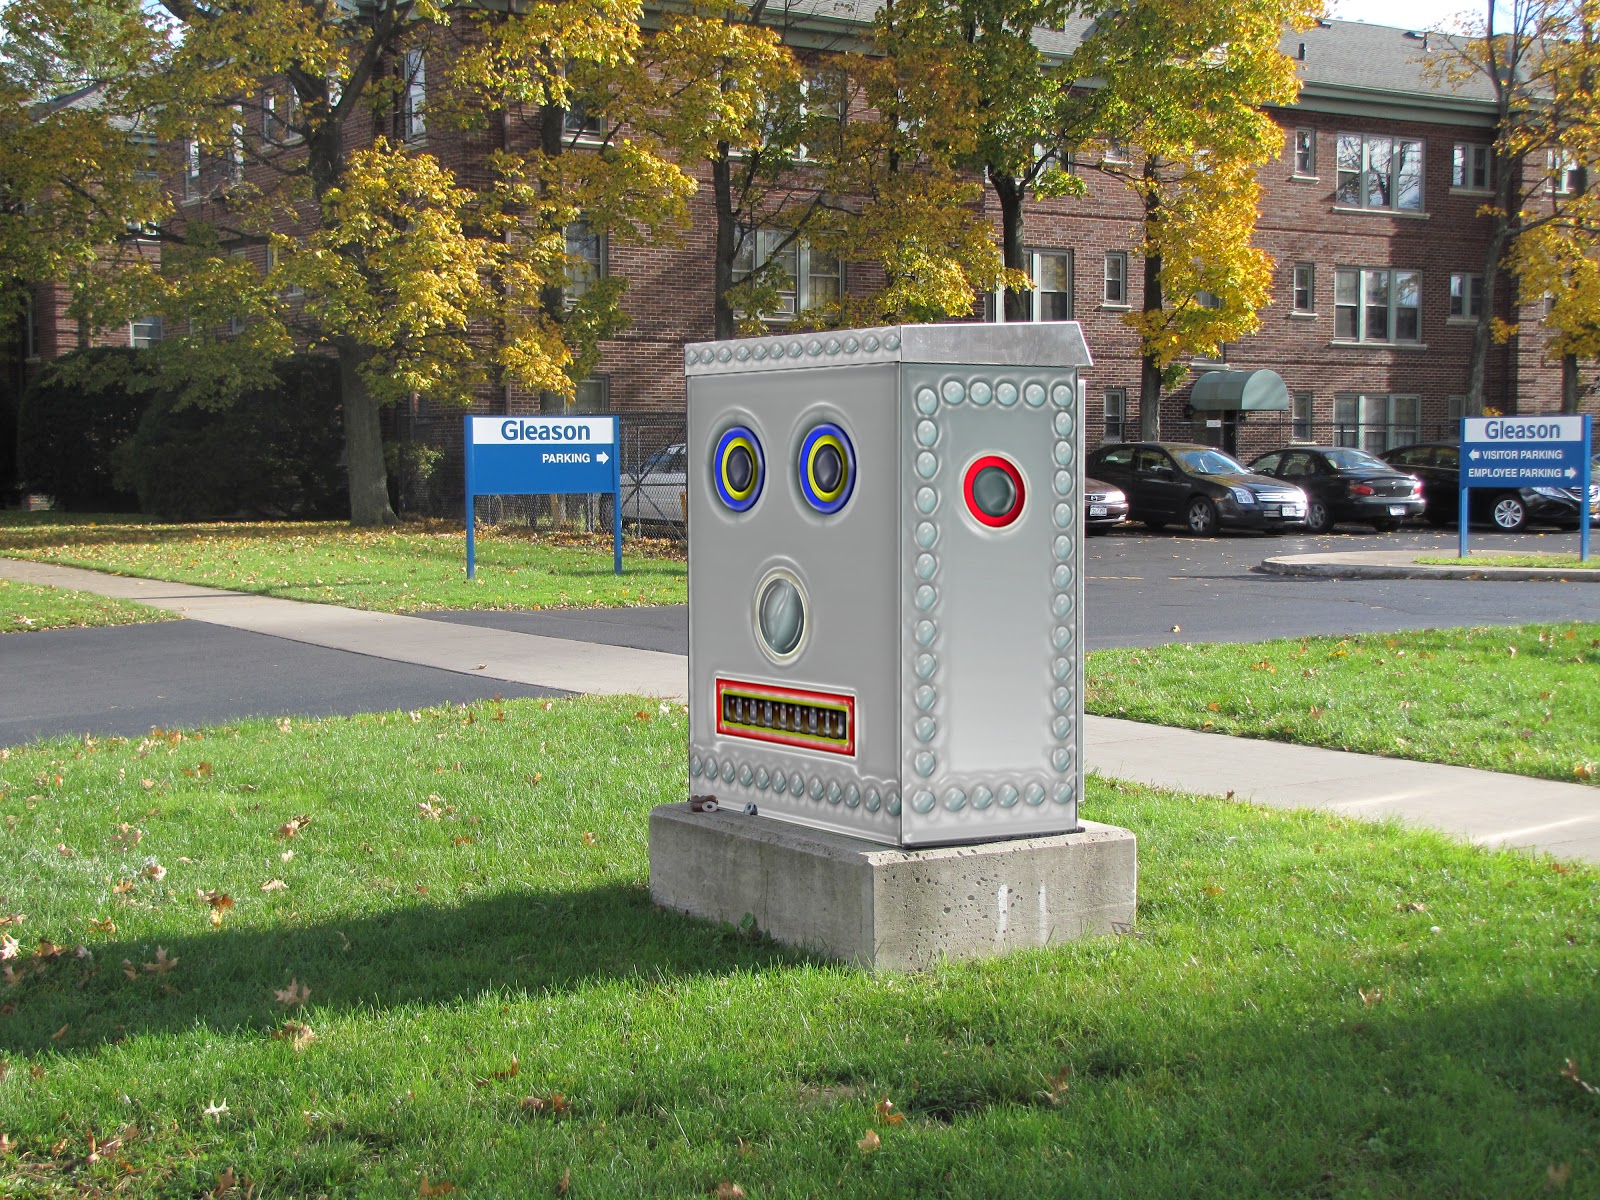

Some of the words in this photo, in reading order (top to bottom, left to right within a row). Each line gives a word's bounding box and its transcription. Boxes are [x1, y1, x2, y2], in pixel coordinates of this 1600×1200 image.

[501, 420, 591, 441] Gleason
[1484, 421, 1560, 439] Gleason
[542, 453, 591, 464] PARKING
[1482, 450, 1518, 460] VISITOR
[1520, 450, 1562, 460] PARKING
[1468, 468, 1518, 478] EMPLOYEE
[1519, 468, 1561, 478] PARKING
